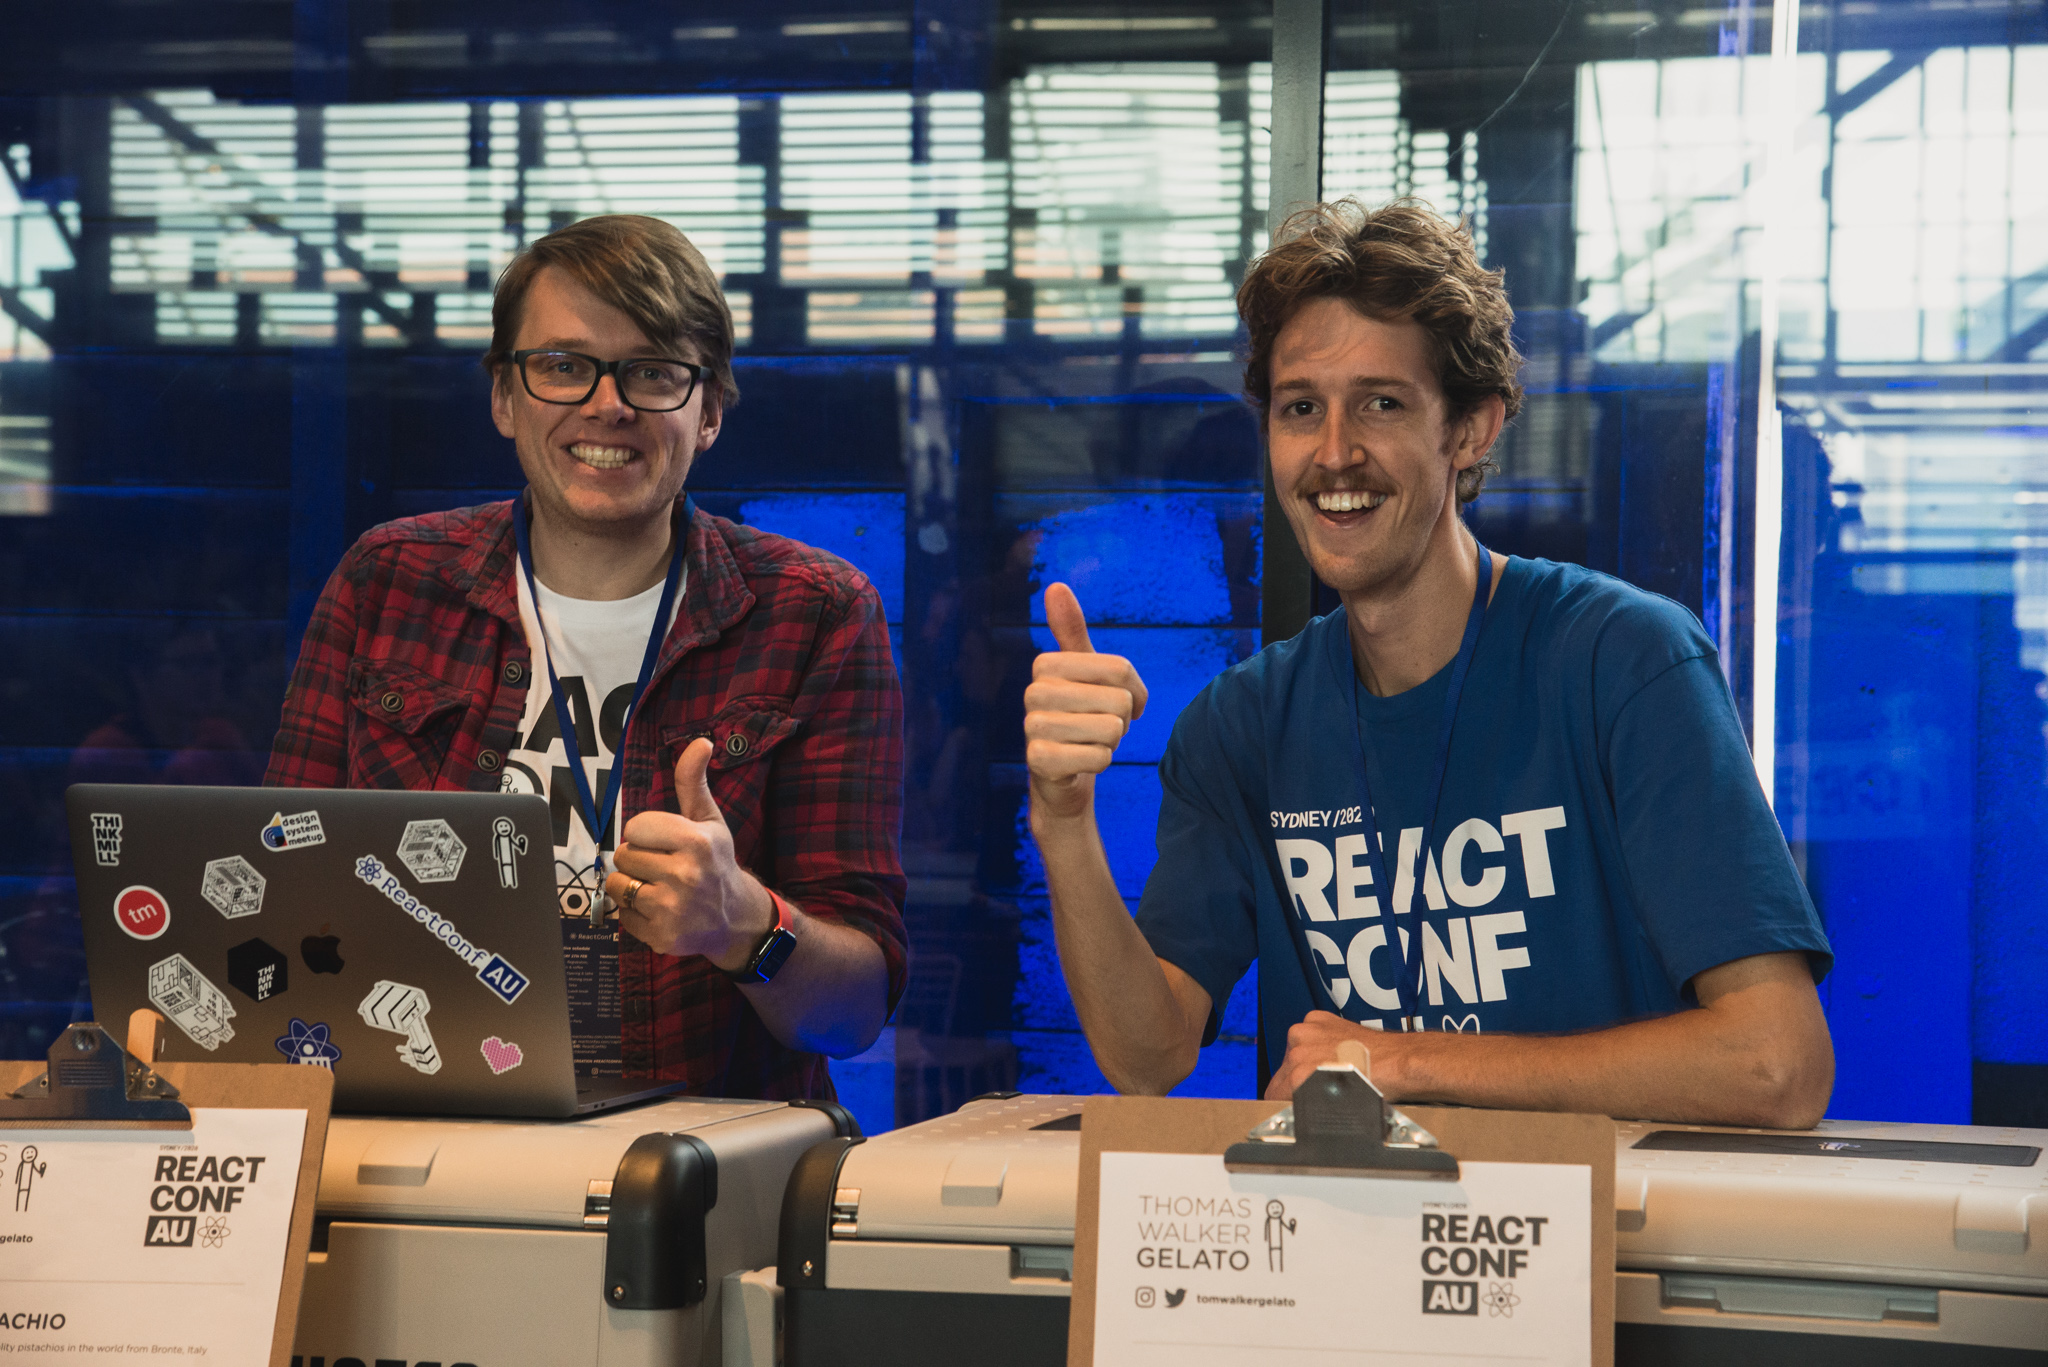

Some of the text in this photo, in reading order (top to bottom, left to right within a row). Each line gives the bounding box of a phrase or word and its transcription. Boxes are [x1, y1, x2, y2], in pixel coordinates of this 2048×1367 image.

[93, 816, 120, 828] THI
[282, 815, 317, 827] design
[1270, 805, 1375, 829] SYDNEY/202
[95, 828, 119, 840] NK
[286, 824, 320, 837] system
[288, 834, 323, 846] meetup
[97, 840, 118, 851] MI
[99, 852, 117, 863] LL
[1275, 806, 1567, 922] REACT
[128, 904, 158, 924] tm
[381, 877, 520, 994] ReactConf AU
[1305, 911, 1531, 1011] CONF
[154, 1155, 266, 1183] REACT
[150, 1185, 245, 1213] CONF
[1138, 1195, 1251, 1218] THOMAS
[150, 1219, 191, 1244] AU
[1138, 1221, 1250, 1244] WALKER
[1422, 1213, 1549, 1246] REACT
[1136, 1247, 1249, 1271] GELATO
[1421, 1246, 1529, 1279] CONF
[1197, 1294, 1296, 1308] tomwalkergelato
[1428, 1284, 1473, 1312] AU
[17, 1343, 65, 1353] pistachios
[67, 1344, 76, 1352] in
[78, 1344, 94, 1353] the
[97, 1344, 124, 1353] world
[126, 1344, 149, 1354] from
[151, 1344, 185, 1355] Bronte,
[187, 1345, 208, 1356] Italy
